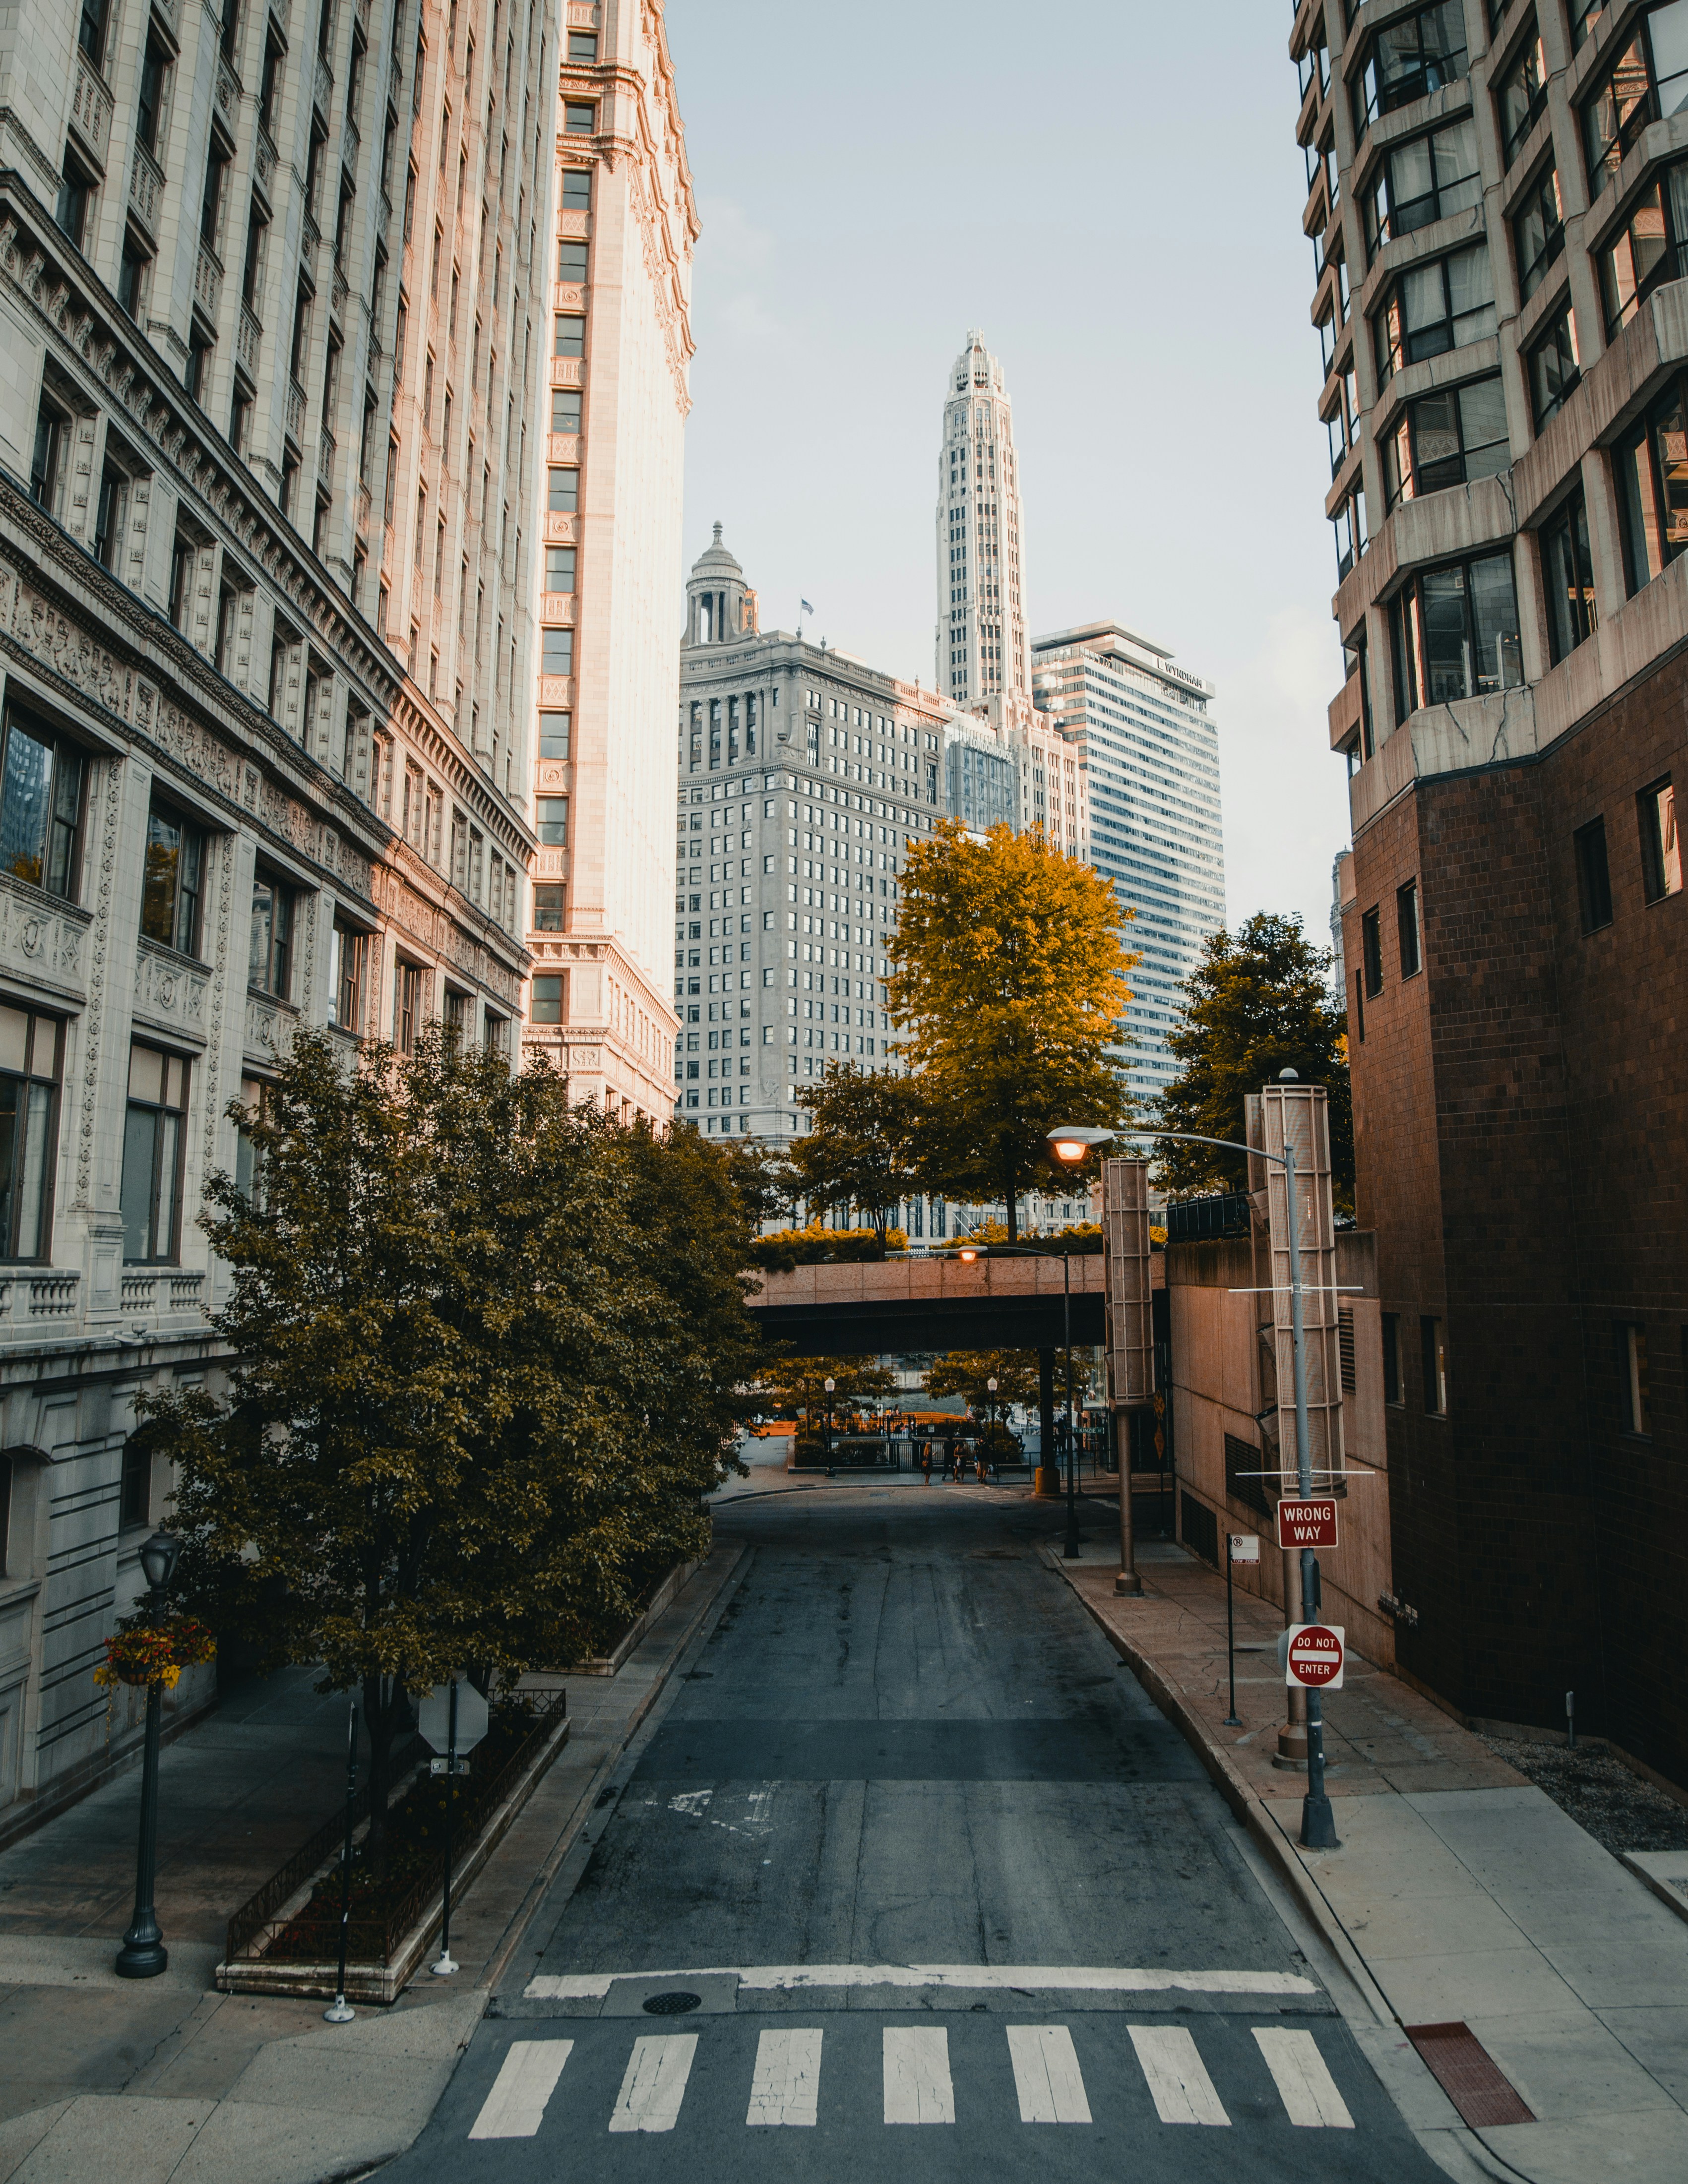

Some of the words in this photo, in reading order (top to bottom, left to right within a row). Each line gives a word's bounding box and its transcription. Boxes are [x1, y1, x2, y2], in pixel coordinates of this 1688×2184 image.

[1165, 662, 1202, 689] WYNDHAM
[969, 736, 1013, 762] LONDONHOUSE
[1284, 1507, 1331, 1521] WRONG
[1294, 1526, 1321, 1540] WAY
[1298, 1637, 1311, 1647] DO
[1316, 1638, 1335, 1648] NOT
[1299, 1664, 1330, 1675] ENTER
